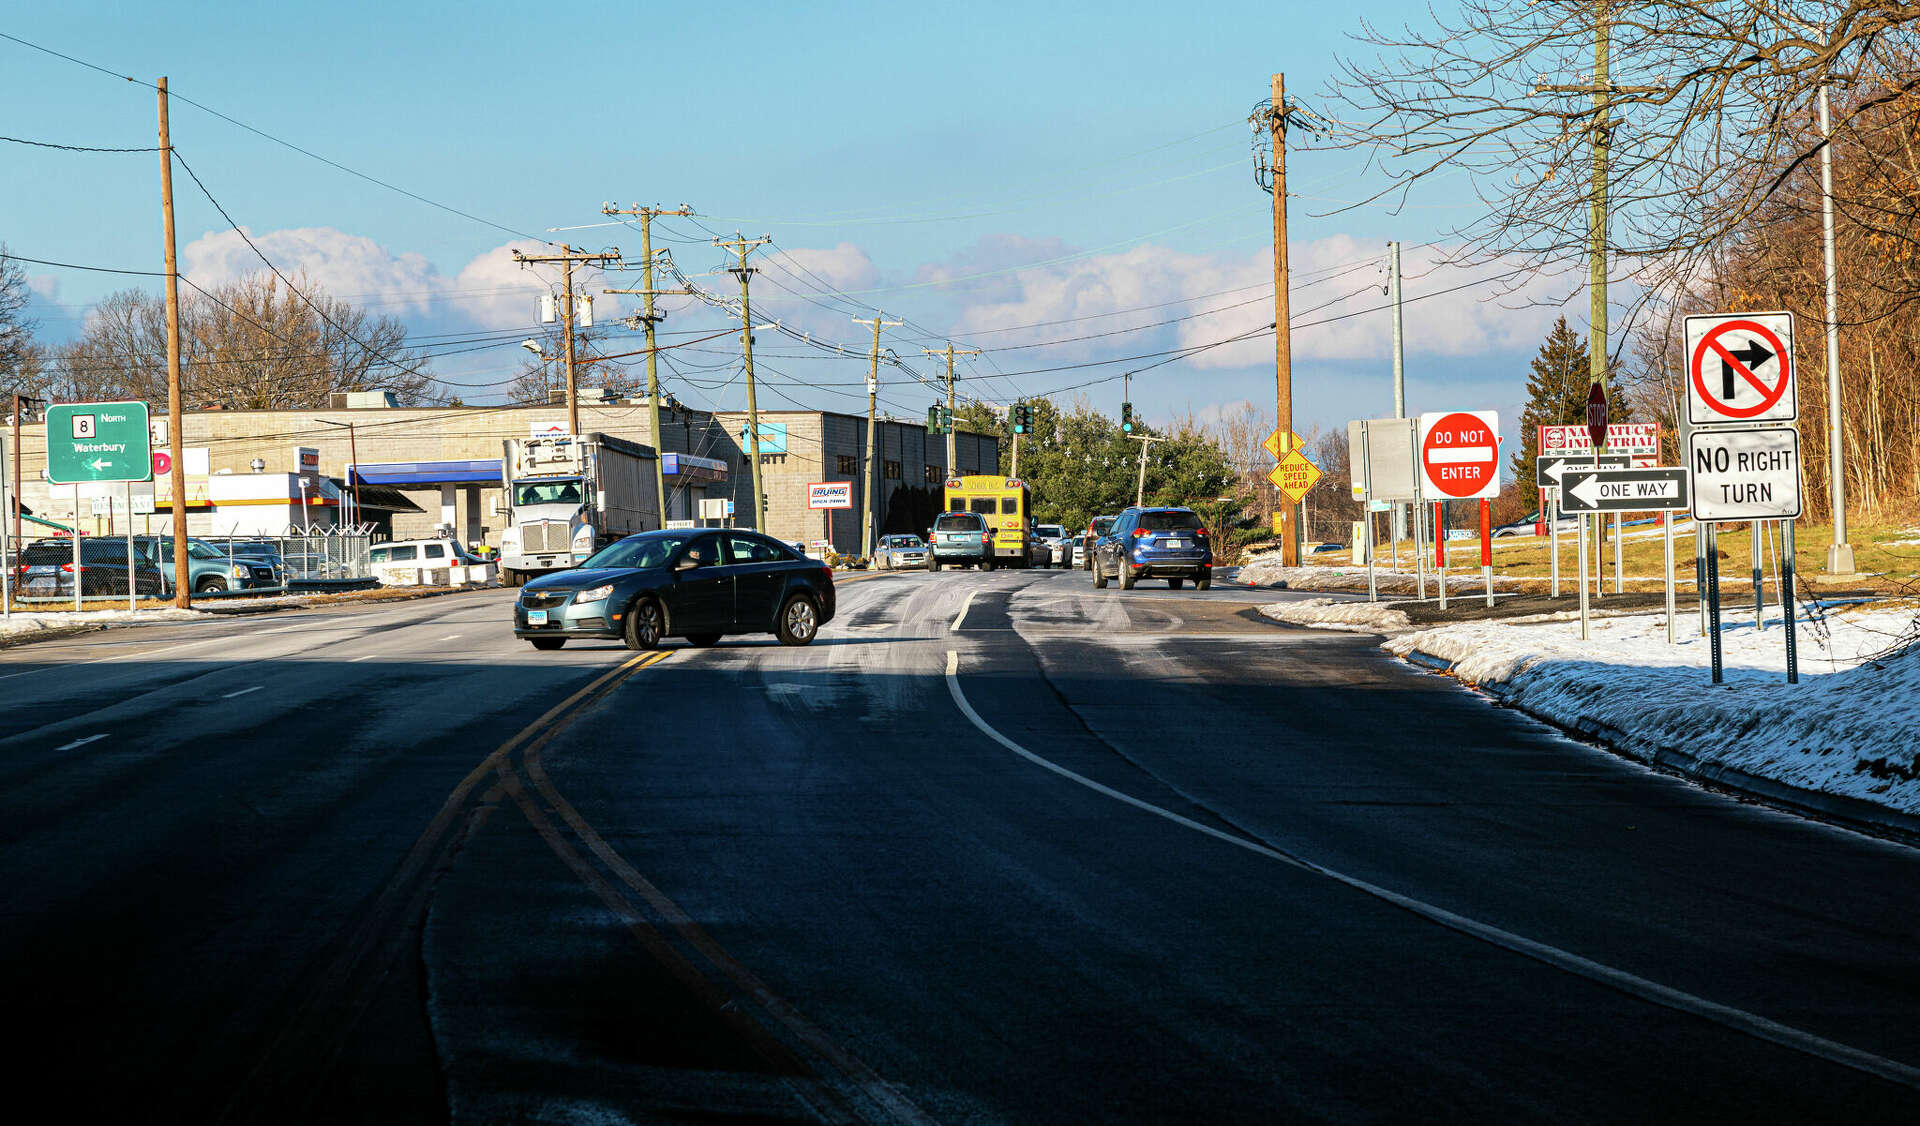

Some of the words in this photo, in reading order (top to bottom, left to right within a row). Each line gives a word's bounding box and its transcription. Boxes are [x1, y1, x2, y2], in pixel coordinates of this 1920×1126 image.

[1588, 403, 1606, 426] STOP
[80, 420, 88, 432] 8
[1568, 425, 1657, 437] NAATUCK
[1435, 431, 1452, 444] DO
[1460, 430, 1485, 443] NOT
[73, 443, 126, 453] Waterbury
[1697, 447, 1730, 474] NO
[1738, 450, 1792, 472] RIGHT
[1280, 463, 1309, 472] REDUCE
[1441, 466, 1480, 480] ENTER
[1284, 472, 1307, 480] SPEED
[1284, 481, 1308, 489] AHEAD
[1600, 484, 1631, 497] ONE
[1637, 482, 1668, 496] WAY
[813, 488, 846, 496] IRVING
[1720, 482, 1772, 504] TURN
